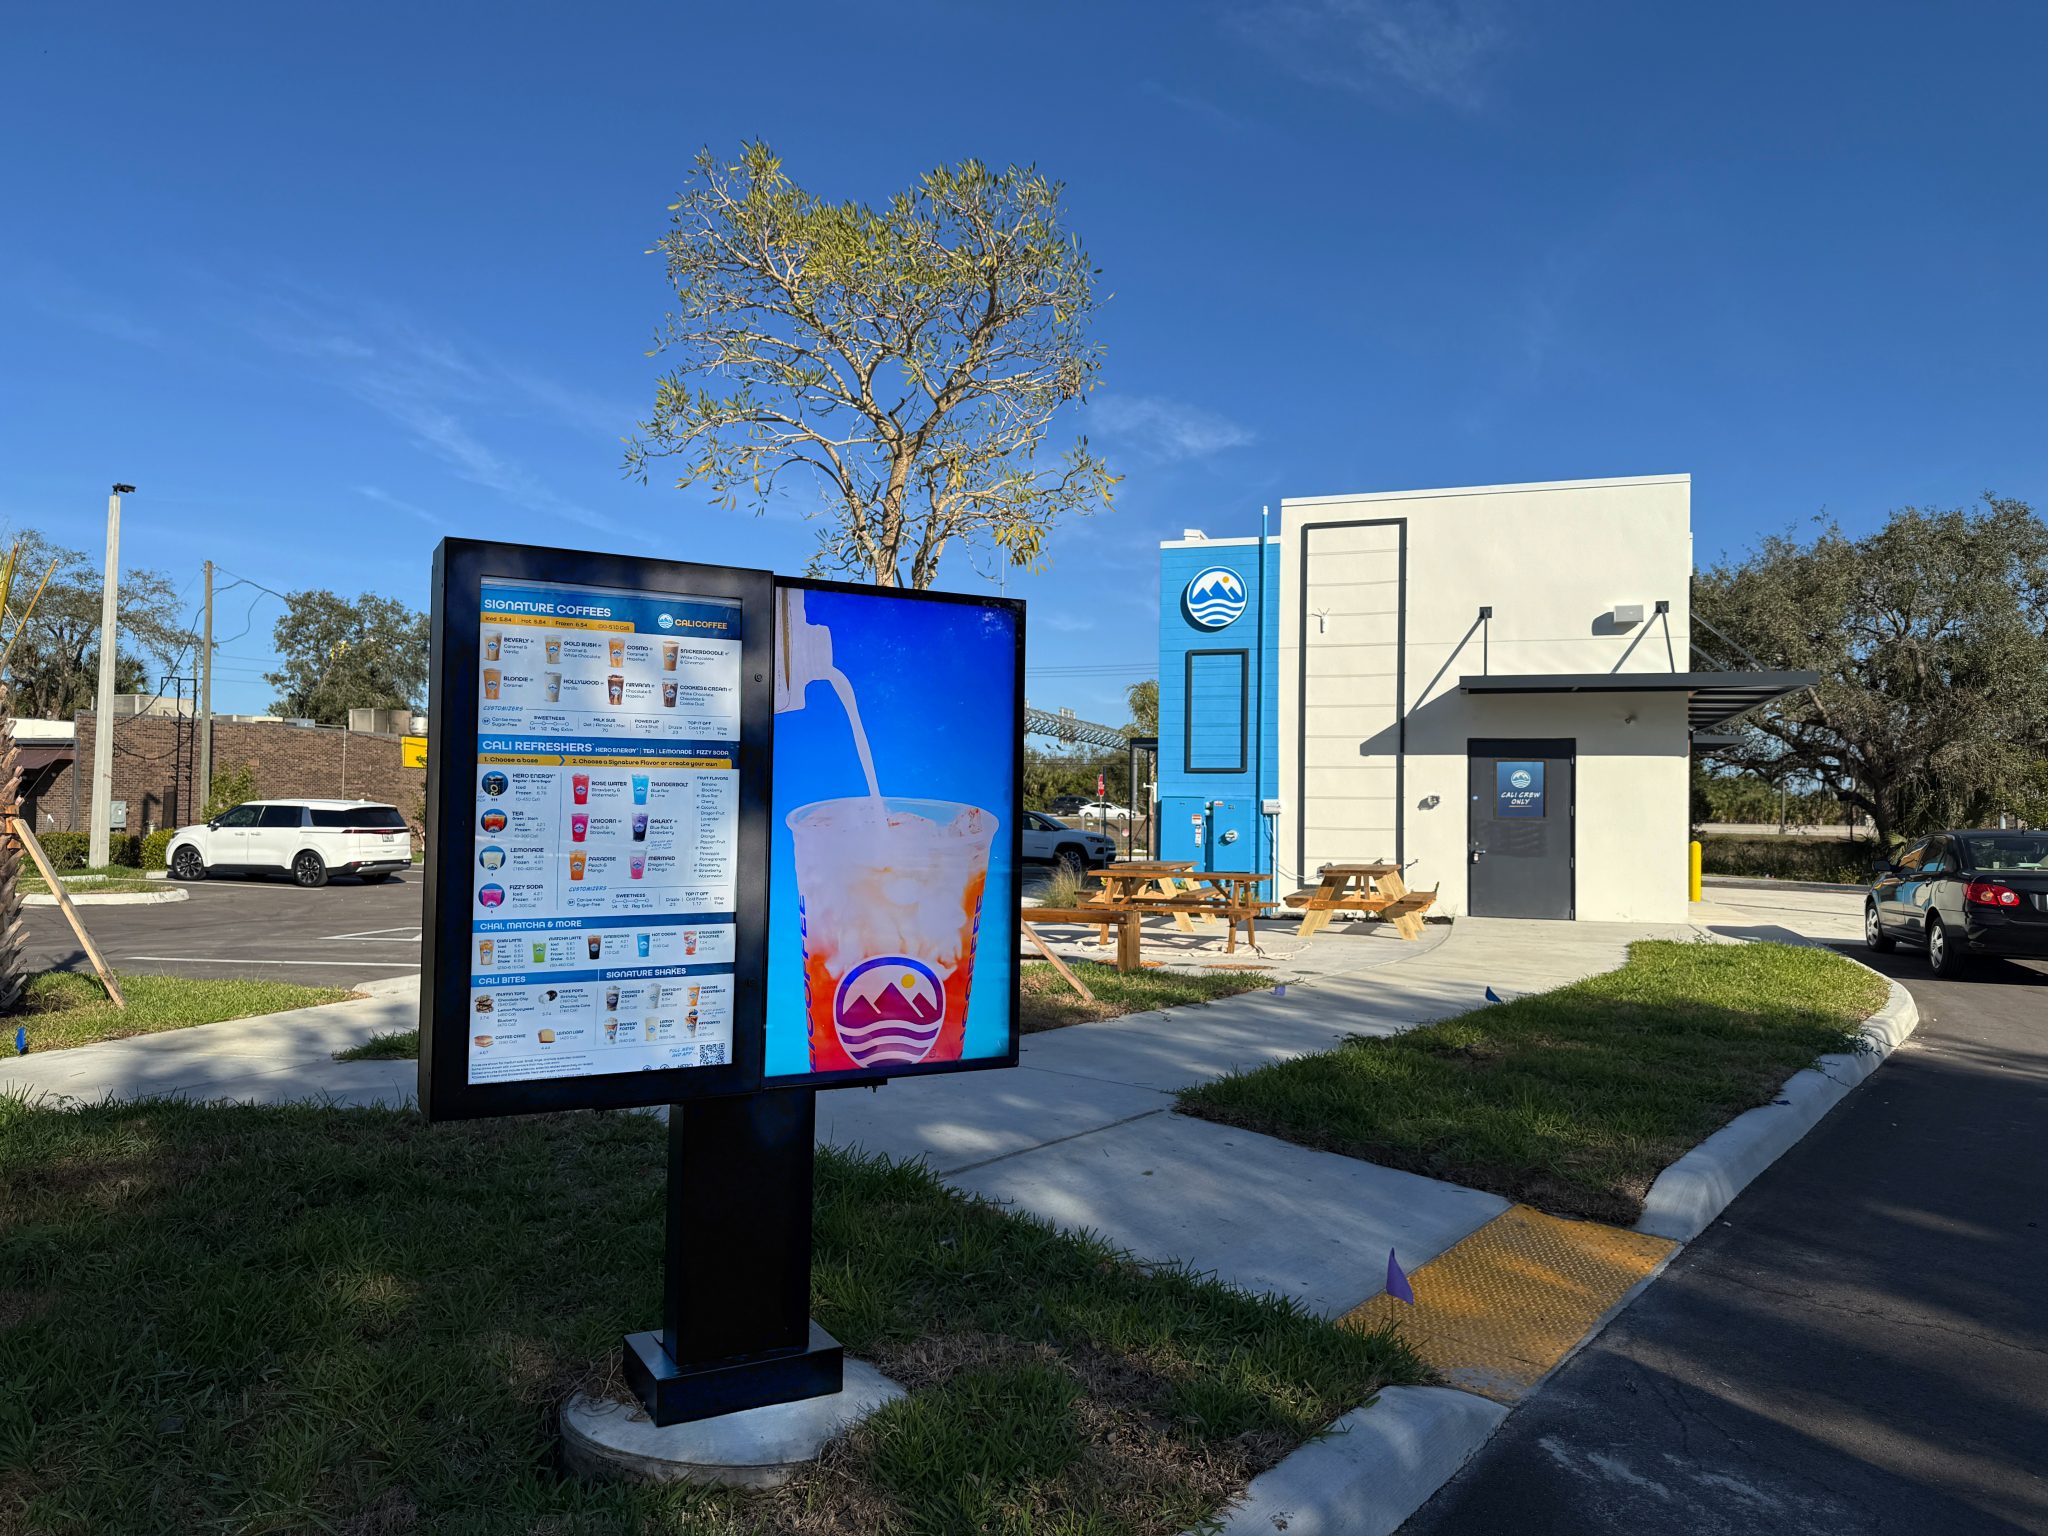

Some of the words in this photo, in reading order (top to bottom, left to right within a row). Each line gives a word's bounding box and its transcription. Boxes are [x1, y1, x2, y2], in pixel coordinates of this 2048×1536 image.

[484, 599, 554, 613] SIGNATURE
[557, 604, 611, 617] COFFEES
[482, 740, 512, 750] CALI
[515, 741, 593, 752] REFRESHERS
[480, 923, 505, 931] CHAI,
[507, 921, 546, 929] MATCHA
[556, 920, 582, 928] MORE
[606, 969, 653, 978] SIGNATURE
[654, 968, 687, 976] SHAKES
[479, 977, 500, 985] CALI
[502, 976, 526, 984] BITES
